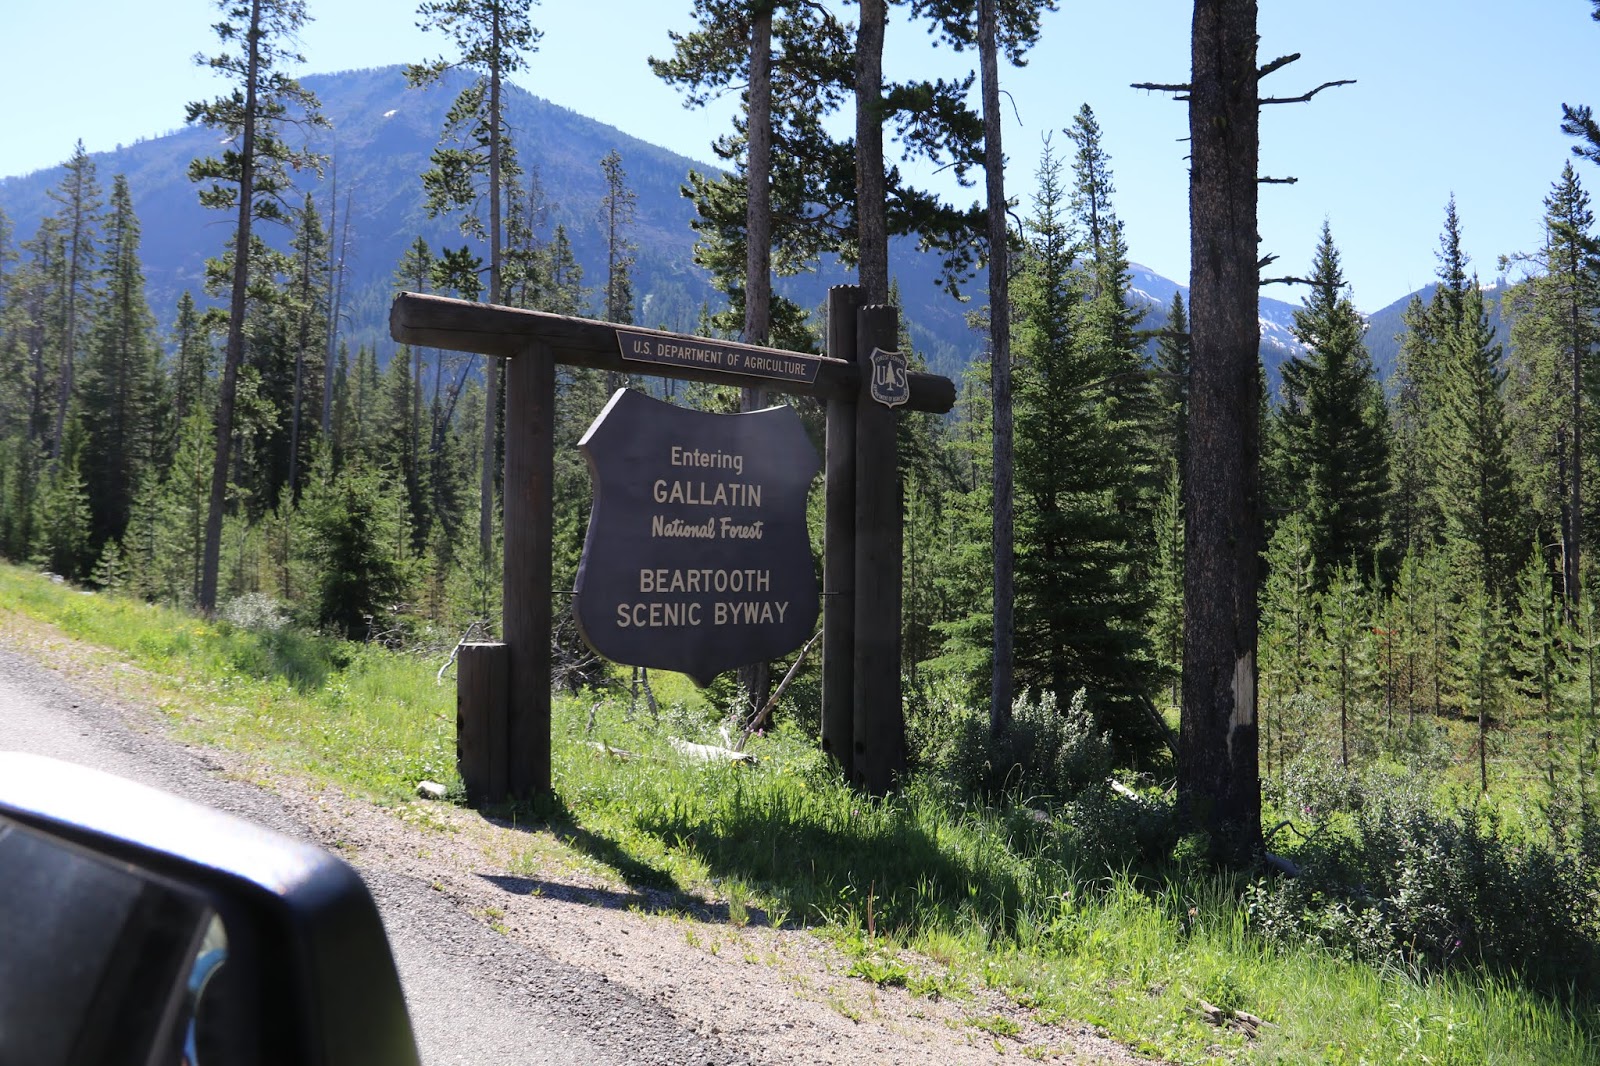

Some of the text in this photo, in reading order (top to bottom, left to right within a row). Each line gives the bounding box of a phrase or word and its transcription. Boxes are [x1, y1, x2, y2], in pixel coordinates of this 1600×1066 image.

[633, 341, 806, 376] U.S. DEPARTMENT OF AGRICULTURE
[671, 446, 743, 475] Entering
[653, 480, 761, 507] GALLATIN
[652, 515, 764, 540] National Forest
[640, 569, 770, 593] BEARTOOTH
[616, 601, 789, 628] SCENIC BYWAY
